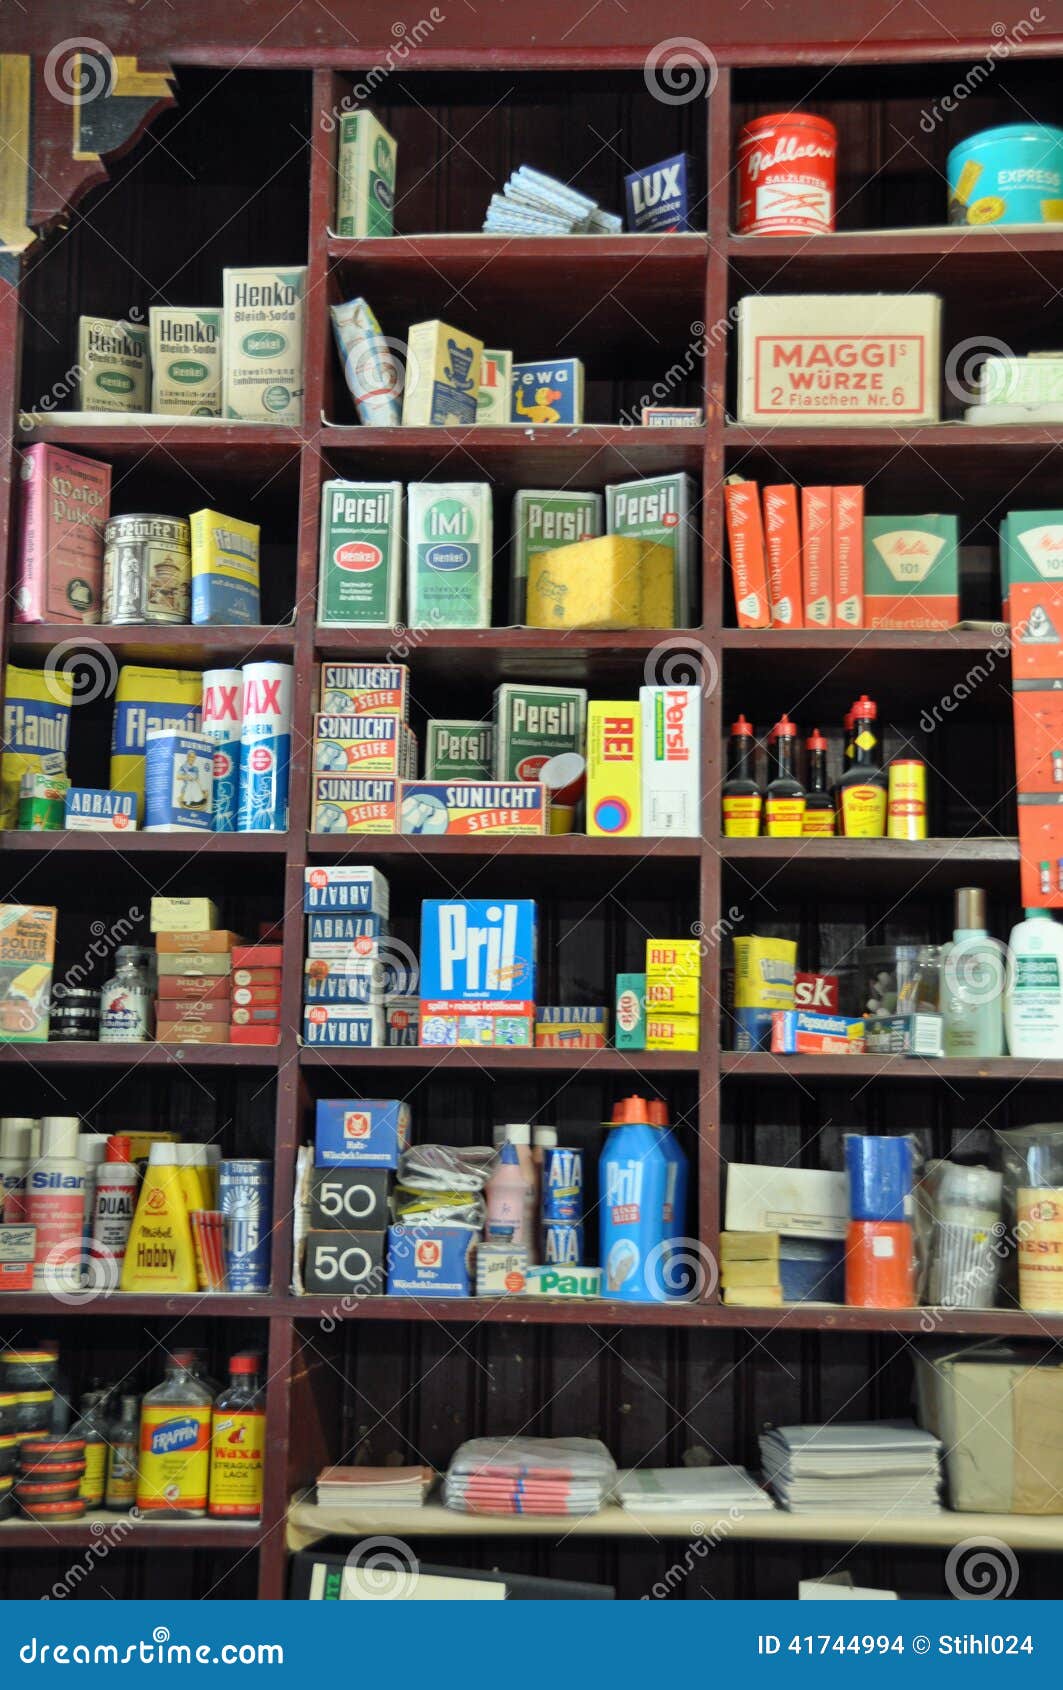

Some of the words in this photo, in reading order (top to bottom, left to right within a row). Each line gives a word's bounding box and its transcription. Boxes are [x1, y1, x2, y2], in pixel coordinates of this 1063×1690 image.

[998, 168, 1061, 187] EXPRESS
[630, 164, 680, 214] LUX
[235, 283, 296, 307] Henko
[160, 320, 216, 343] Henko
[88, 330, 143, 358] Henko
[789, 370, 883, 389] WÜRZE
[771, 388, 783, 405] 2
[789, 393, 859, 406] Flaschen
[332, 492, 390, 524] Persil
[615, 486, 674, 529] Persil
[528, 504, 591, 541] Persil
[340, 550, 375, 563] Henkel
[899, 562, 920, 574] 101
[326, 667, 400, 689] SUNLICHT
[357, 691, 394, 709] SEIFE
[512, 698, 576, 736] Persil
[666, 690, 690, 761] Persil
[4, 705, 69, 753] Flamil
[318, 717, 394, 739] SUNLICHT
[436, 730, 492, 761] Persil
[604, 717, 634, 761] REI
[351, 742, 388, 759] SEIFE
[318, 780, 394, 801] SUNLICHT
[446, 787, 536, 808] SUNLICHT
[71, 792, 132, 816] ABRAZO
[351, 804, 388, 822] SEIFE
[467, 811, 520, 831] SEIFE
[309, 885, 370, 906] ABRAZO
[313, 918, 374, 938] ABRAZO
[438, 904, 518, 991] Pril
[650, 949, 677, 964] REI
[307, 977, 368, 997] ABRAZO
[648, 986, 674, 1002] REI
[542, 1007, 598, 1023] ABRAZO
[307, 1022, 369, 1042] ABRAZO
[648, 1023, 674, 1039] REI
[549, 1154, 582, 1187] ATA
[98, 1196, 132, 1214] DUAL
[319, 1183, 377, 1217] 50
[545, 1228, 580, 1262] ATA
[137, 1242, 176, 1271] Hobby
[314, 1246, 372, 1281] 50
[152, 1420, 198, 1451] FRAPPIN
[213, 1447, 261, 1459] Waxa
[213, 1461, 262, 1471] STRAGULA
[223, 1470, 250, 1479] LACK
